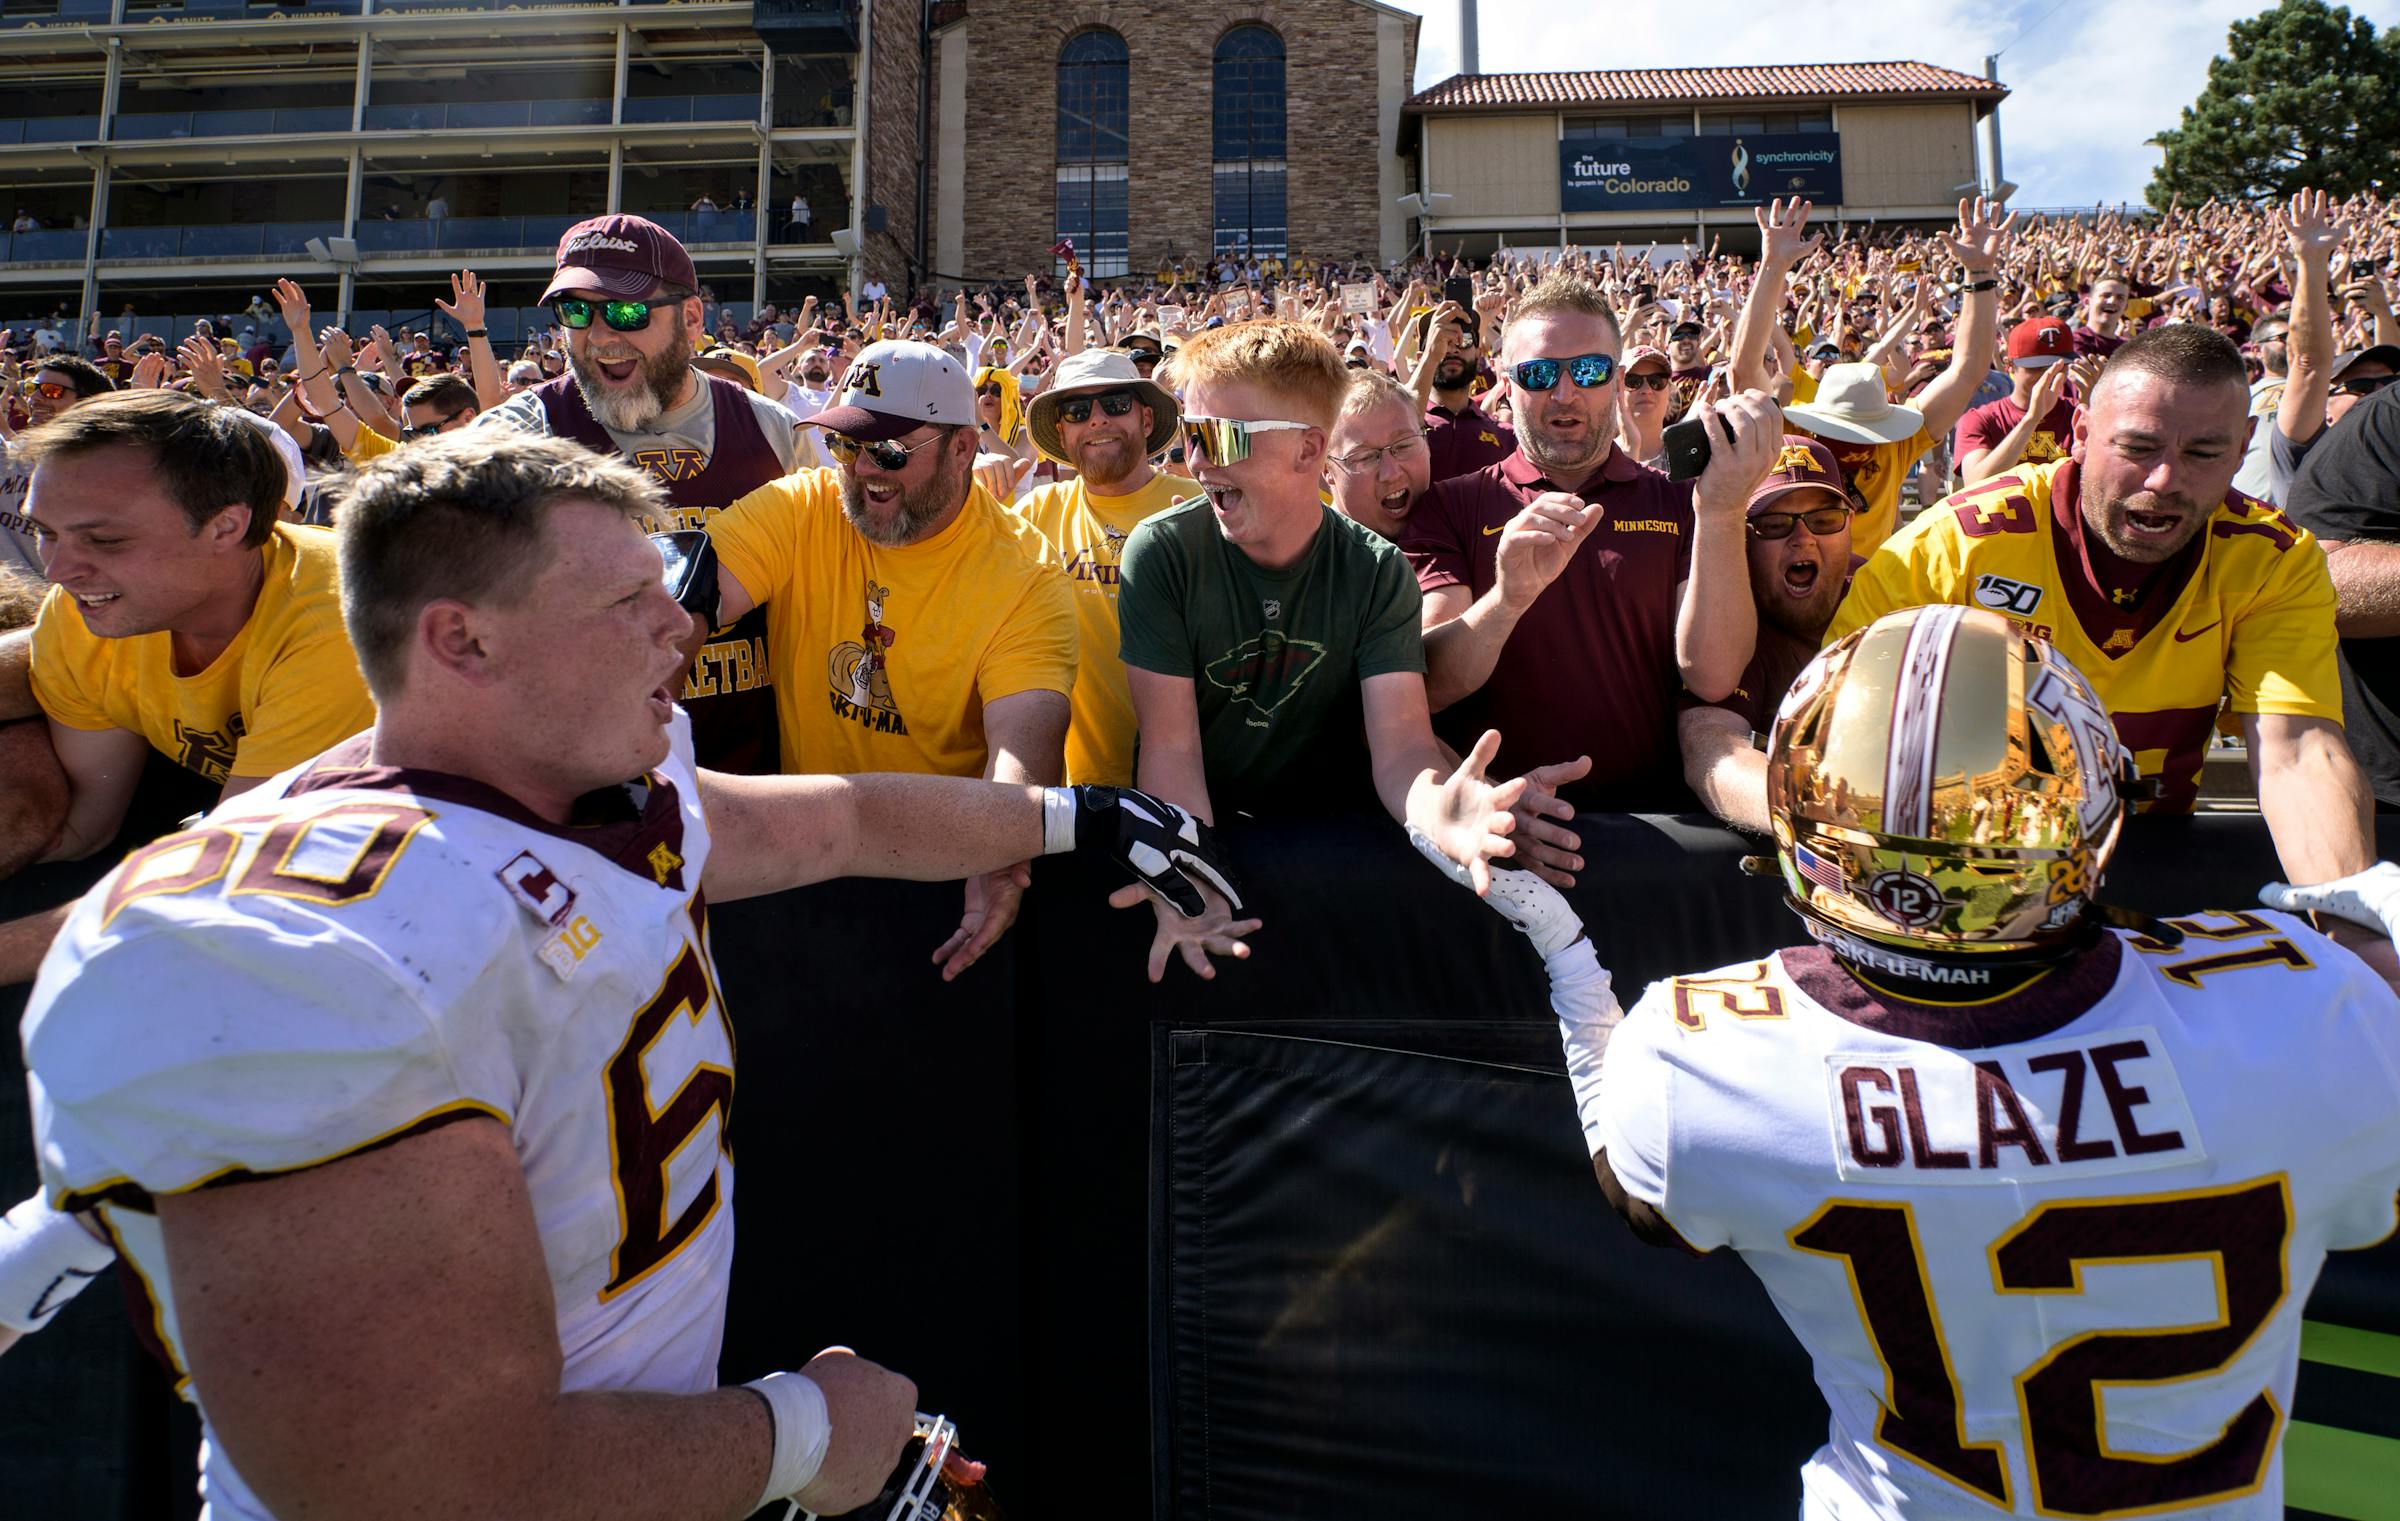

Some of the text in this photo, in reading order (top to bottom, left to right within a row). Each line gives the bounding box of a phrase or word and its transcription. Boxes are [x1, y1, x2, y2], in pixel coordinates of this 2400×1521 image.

[1573, 161, 1631, 177] future
[1756, 150, 1834, 165] synchronicity
[1575, 179, 1597, 188] grown
[1605, 177, 1690, 194] Colorado
[560, 231, 639, 261] Titleist
[1769, 444, 1827, 476] M
[1946, 475, 2038, 538] 13
[1613, 519, 1680, 536] MINNESOTA
[1976, 573, 2043, 617] 150
[647, 841, 687, 891] M
[501, 856, 569, 926] C
[1888, 886, 1922, 914] 12
[1839, 1040, 2186, 1170] GLAZE
[1785, 1171, 2296, 1521] 12
